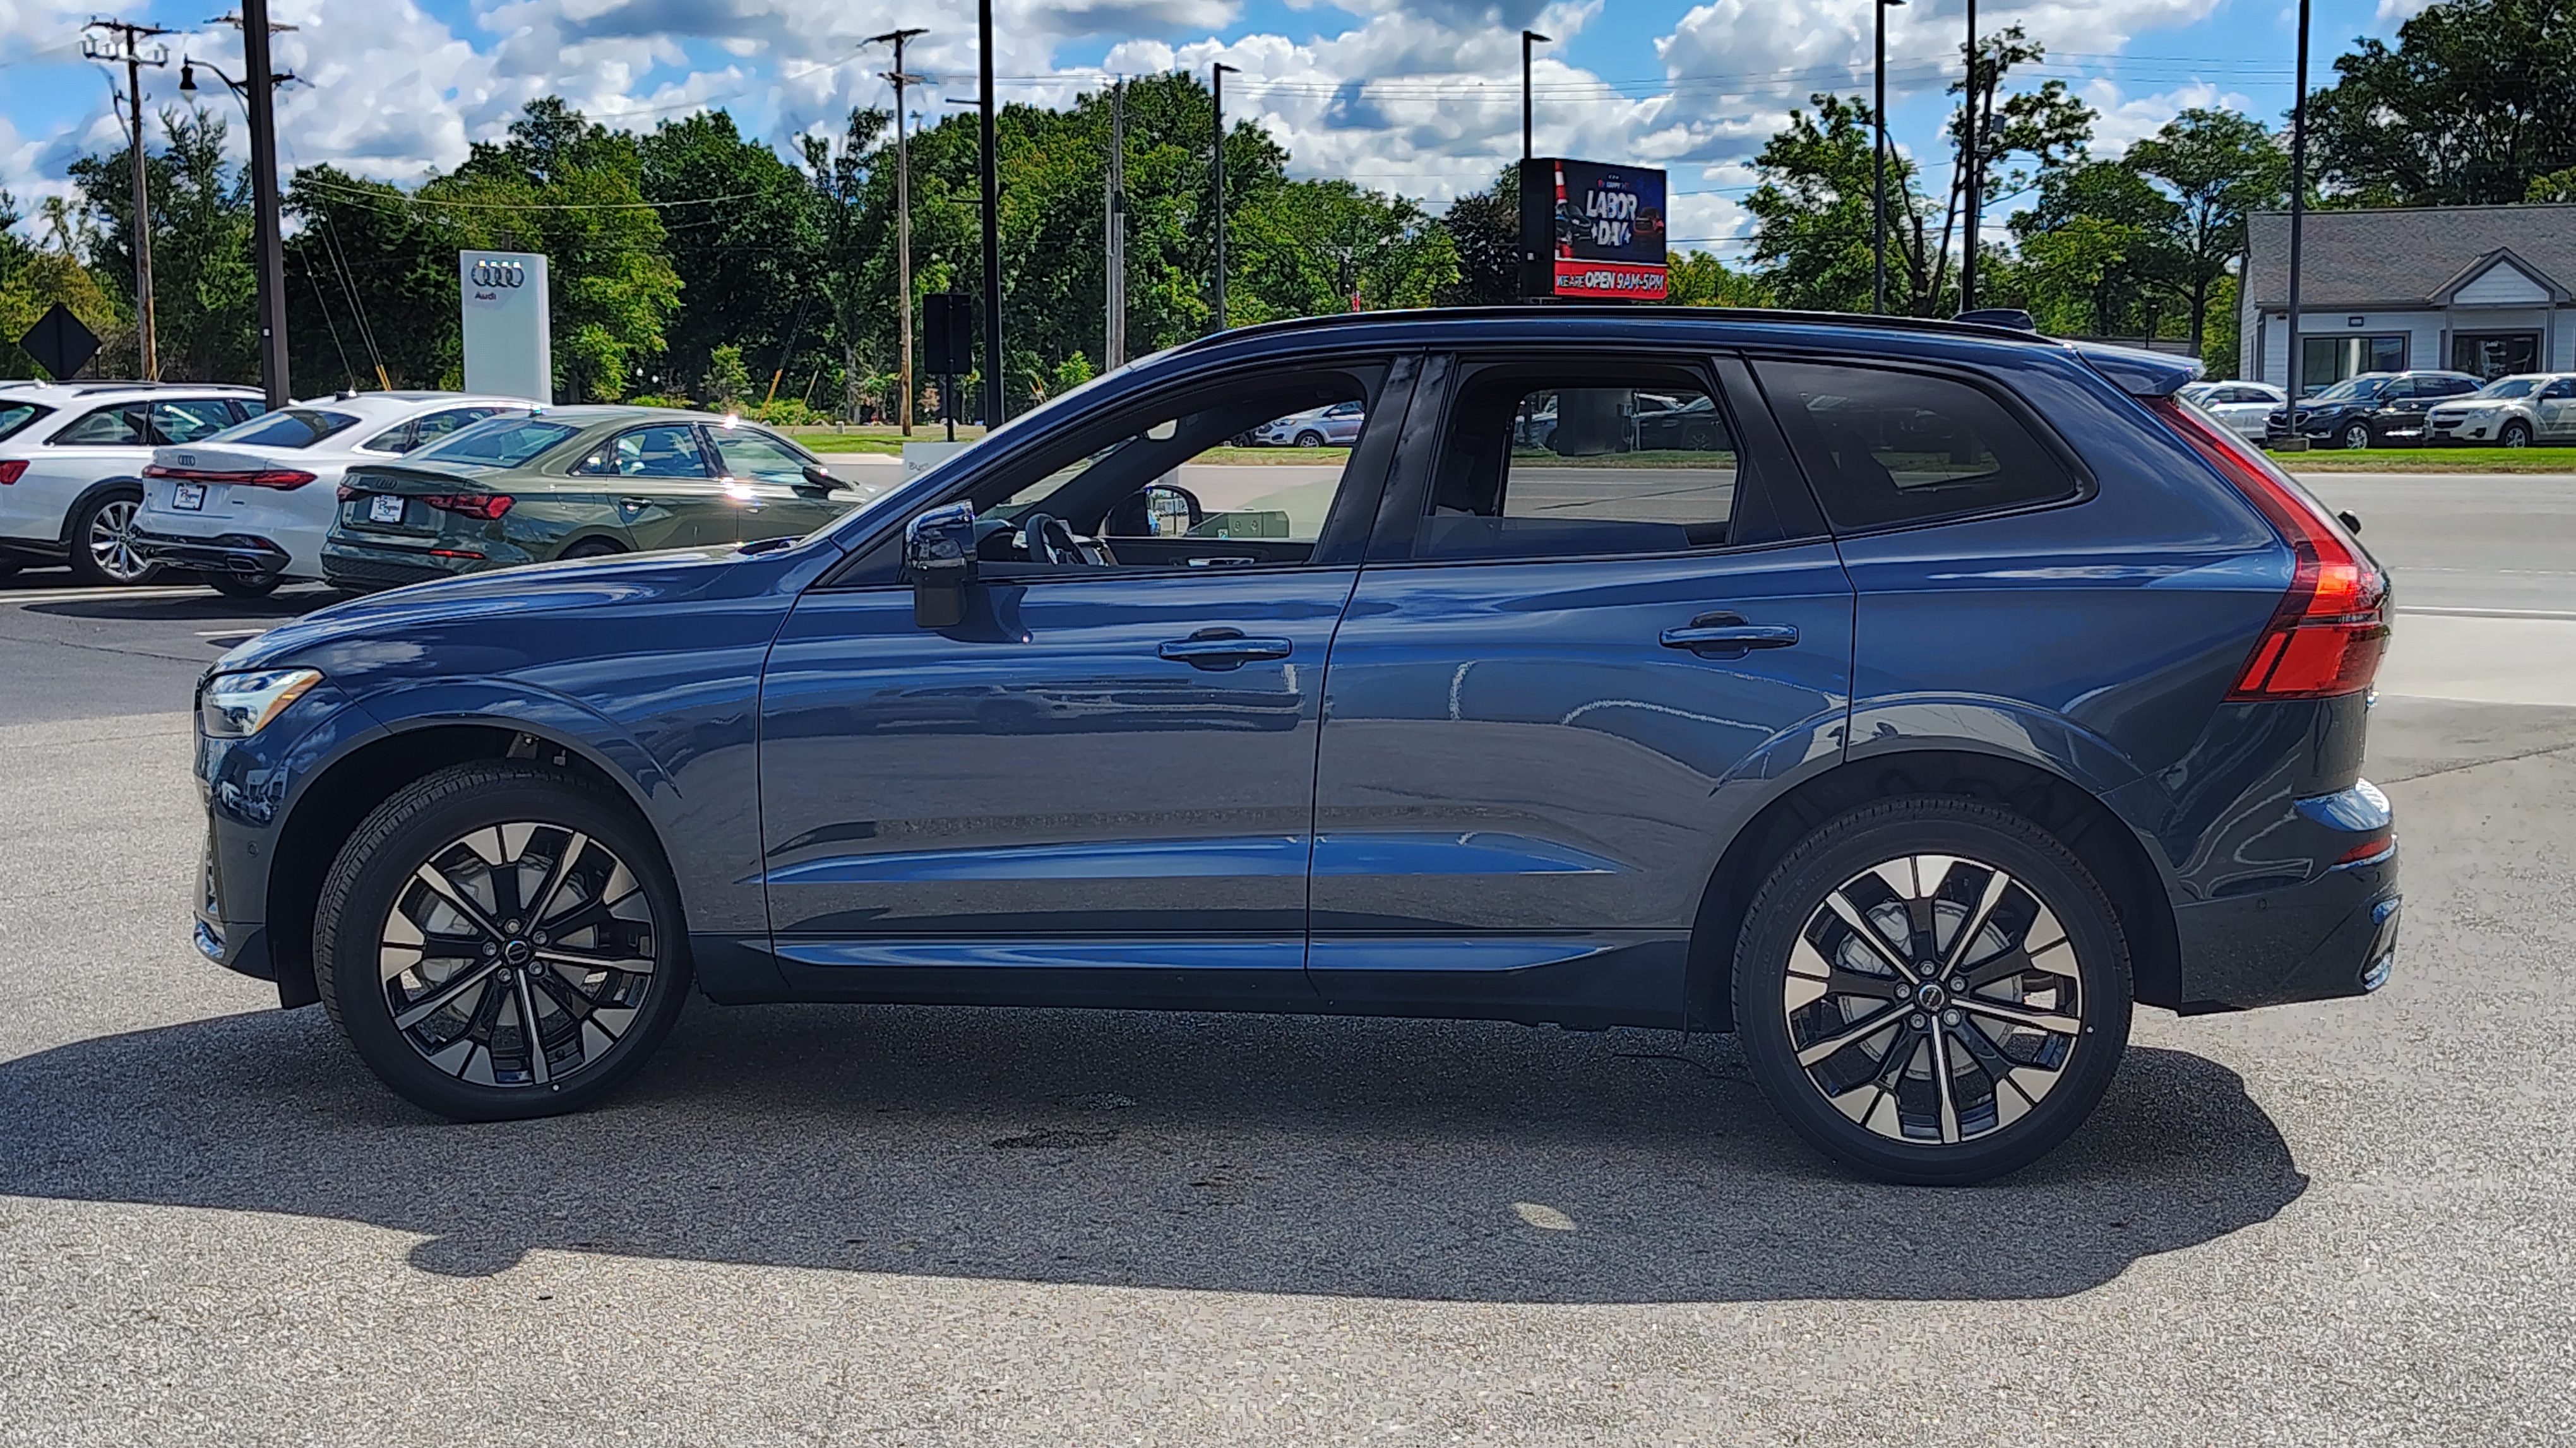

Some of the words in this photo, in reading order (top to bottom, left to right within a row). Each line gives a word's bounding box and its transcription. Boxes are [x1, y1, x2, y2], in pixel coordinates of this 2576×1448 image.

[1585, 190, 1638, 221] LABOR
[1597, 220, 1629, 246] DAY
[1585, 271, 1616, 289] OPEN
[474, 291, 497, 300] Audi
